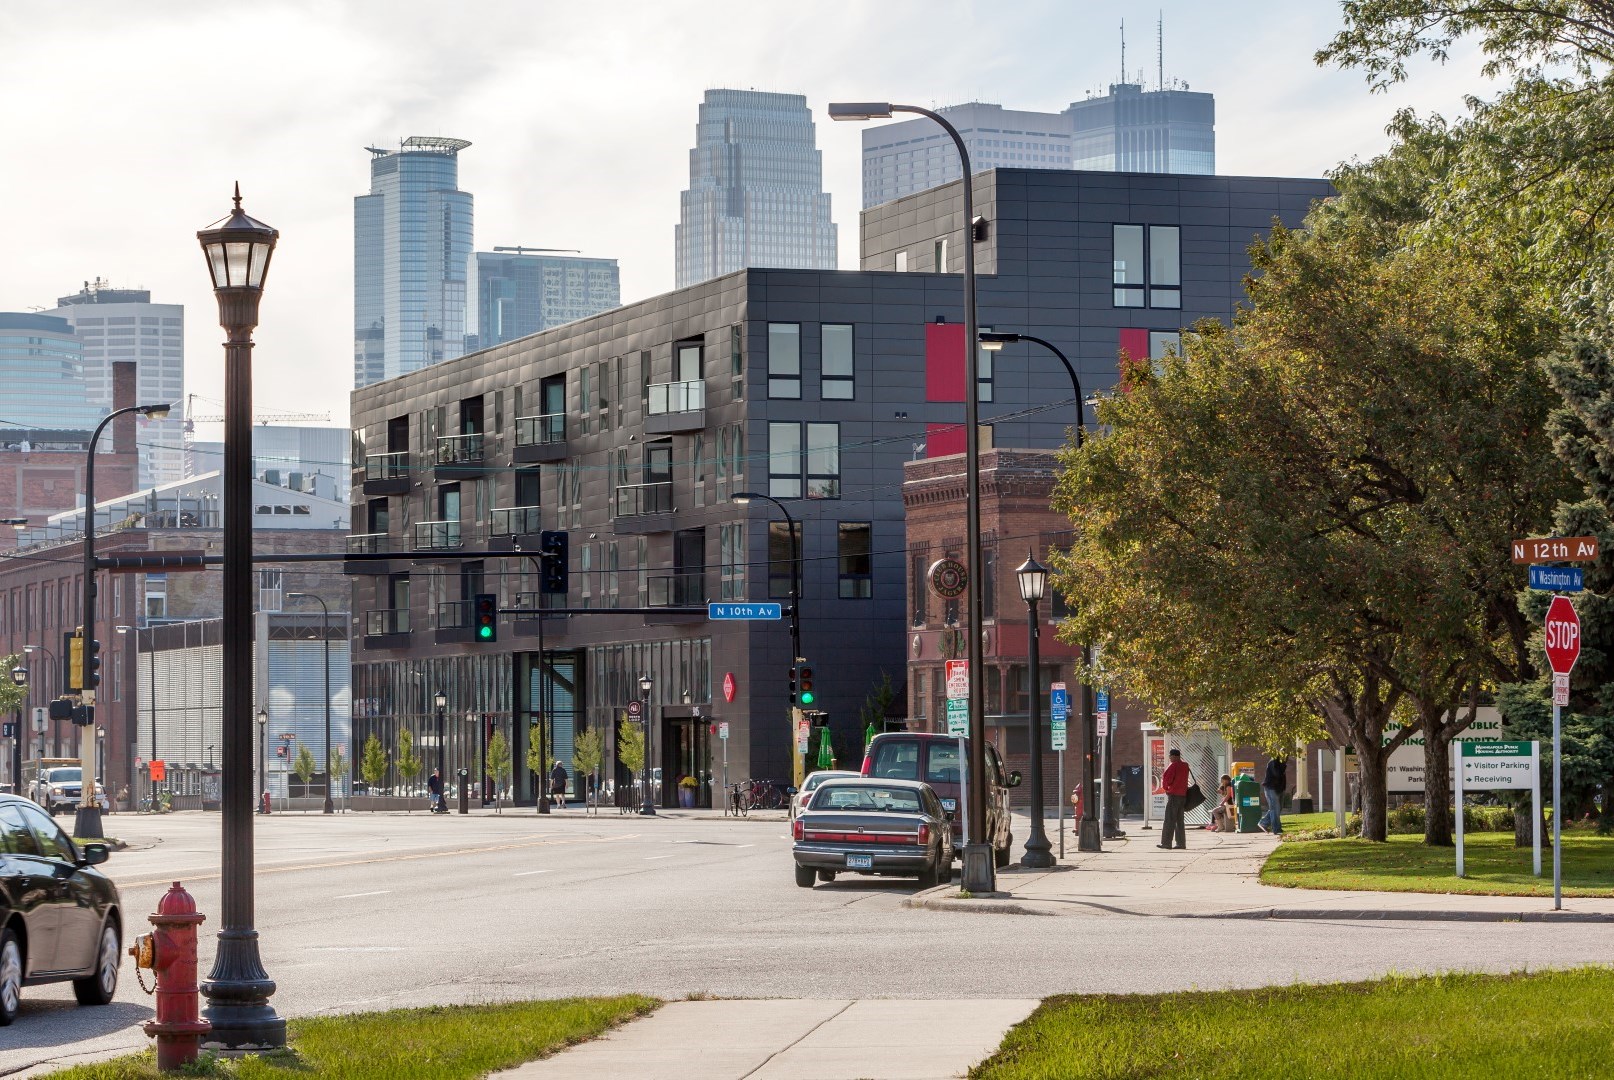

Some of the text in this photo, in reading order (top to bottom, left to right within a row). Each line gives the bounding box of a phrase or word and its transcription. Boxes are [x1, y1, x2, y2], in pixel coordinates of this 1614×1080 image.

[1514, 541, 1595, 559] N 12th Av
[1531, 570, 1582, 589] N Washington Av
[717, 607, 772, 616] N 10th Av
[1547, 620, 1578, 650] STOP
[1468, 721, 1499, 730] UBLIC
[1500, 762, 1530, 770] Parking
[1474, 775, 1512, 783] Receiving
